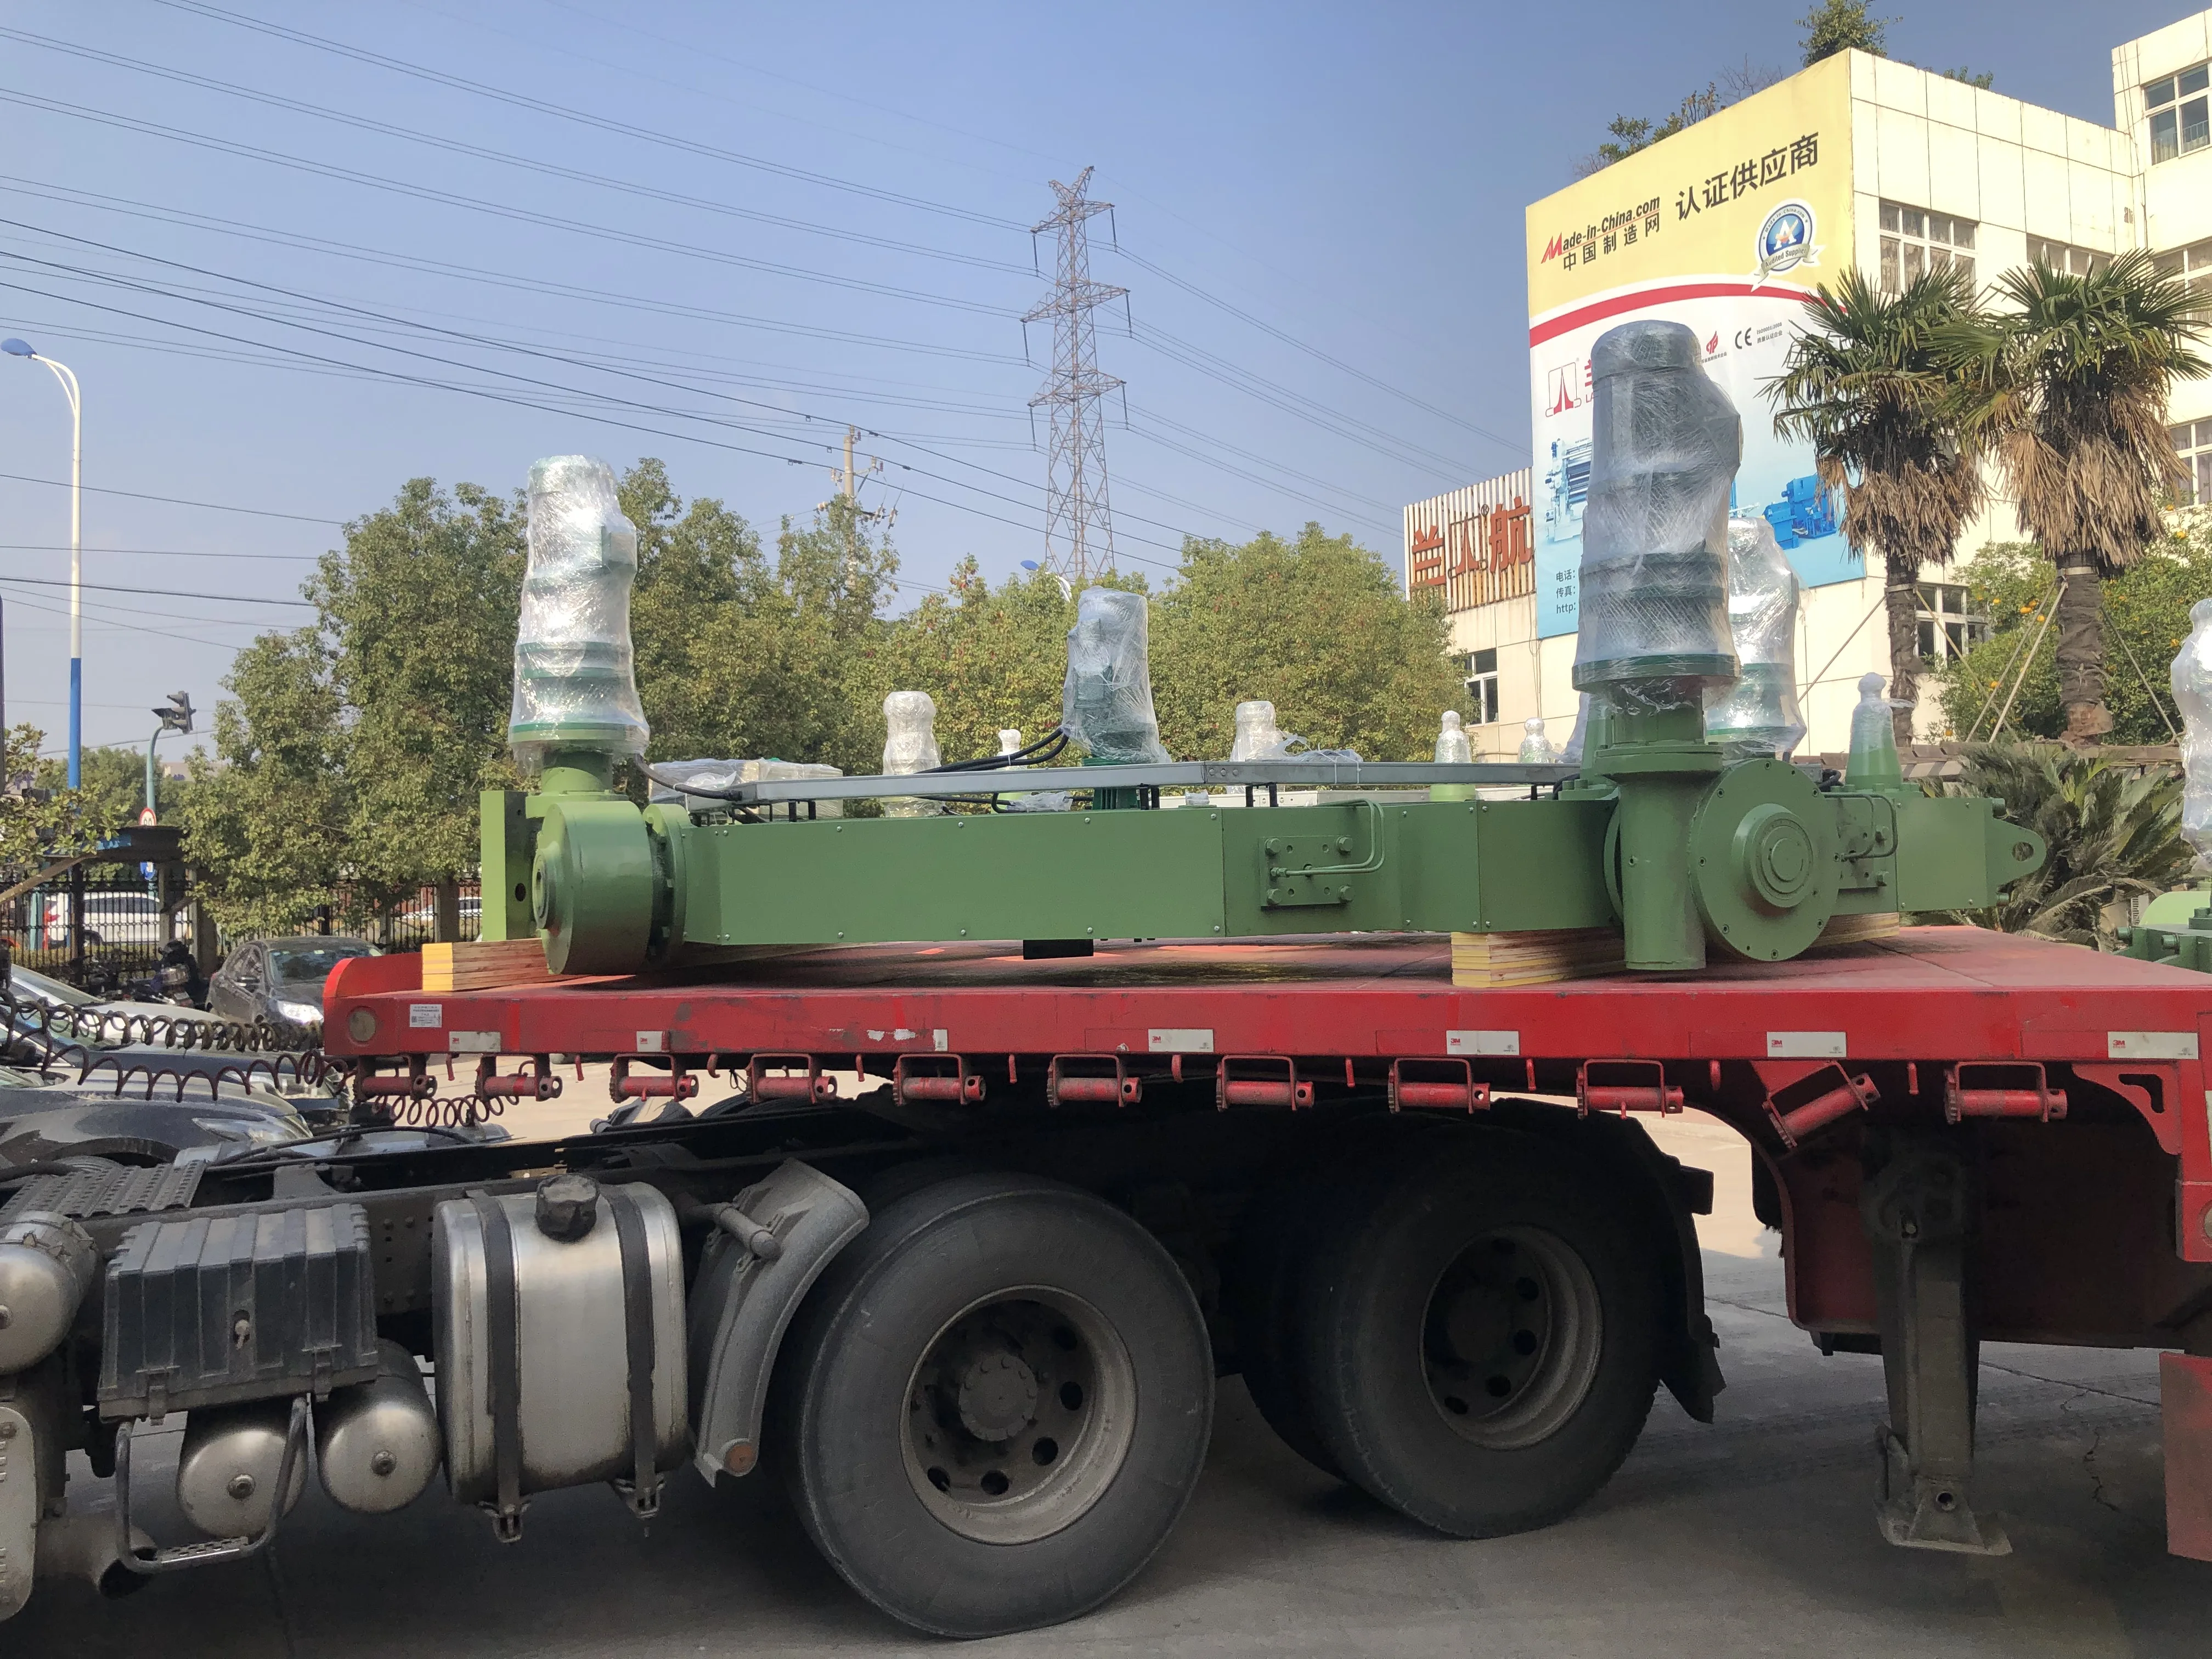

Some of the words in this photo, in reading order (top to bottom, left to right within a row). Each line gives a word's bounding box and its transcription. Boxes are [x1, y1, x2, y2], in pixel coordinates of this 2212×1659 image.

[1675, 131, 1819, 221] 认证供应商
[1541, 196, 1660, 264] Made-in-China.com
[1563, 212, 1660, 272] 中国制造网
[1764, 252, 1784, 268] Audited
[1785, 247, 1807, 258] Supplier
[1735, 327, 1752, 349] CE
[1556, 568, 1576, 582] 电话:
[1556, 585, 1576, 599] 传真:
[1556, 602, 1576, 614] http:
